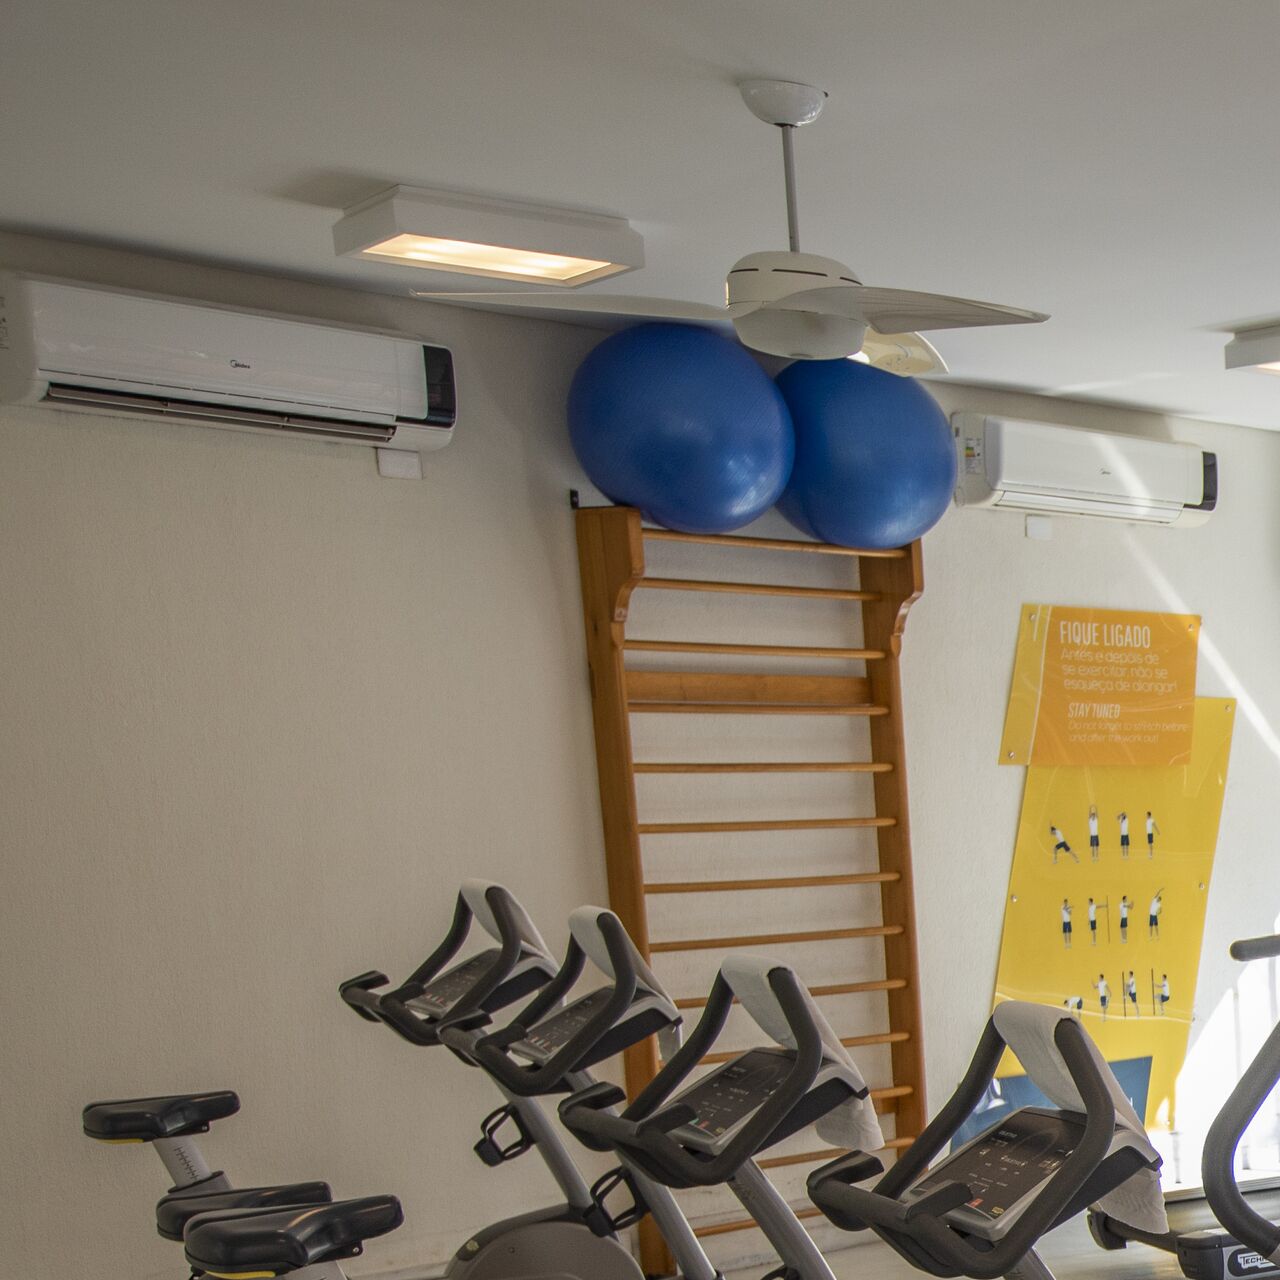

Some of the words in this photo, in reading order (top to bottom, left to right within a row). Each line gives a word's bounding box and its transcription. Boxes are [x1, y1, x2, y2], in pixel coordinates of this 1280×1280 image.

[1060, 620, 1099, 646] FIQUE
[1104, 622, 1151, 648] LIGADO
[1060, 648, 1094, 661] Antes
[1096, 653, 1104, 662] e
[1105, 651, 1144, 665] depois
[1144, 652, 1160, 664] de
[1062, 665, 1076, 676] se
[1154, 668, 1168, 679] se
[1064, 679, 1113, 694] esqueça
[1115, 680, 1131, 692] de
[1068, 702, 1089, 718] STAY
[1092, 703, 1120, 718] TUNED
